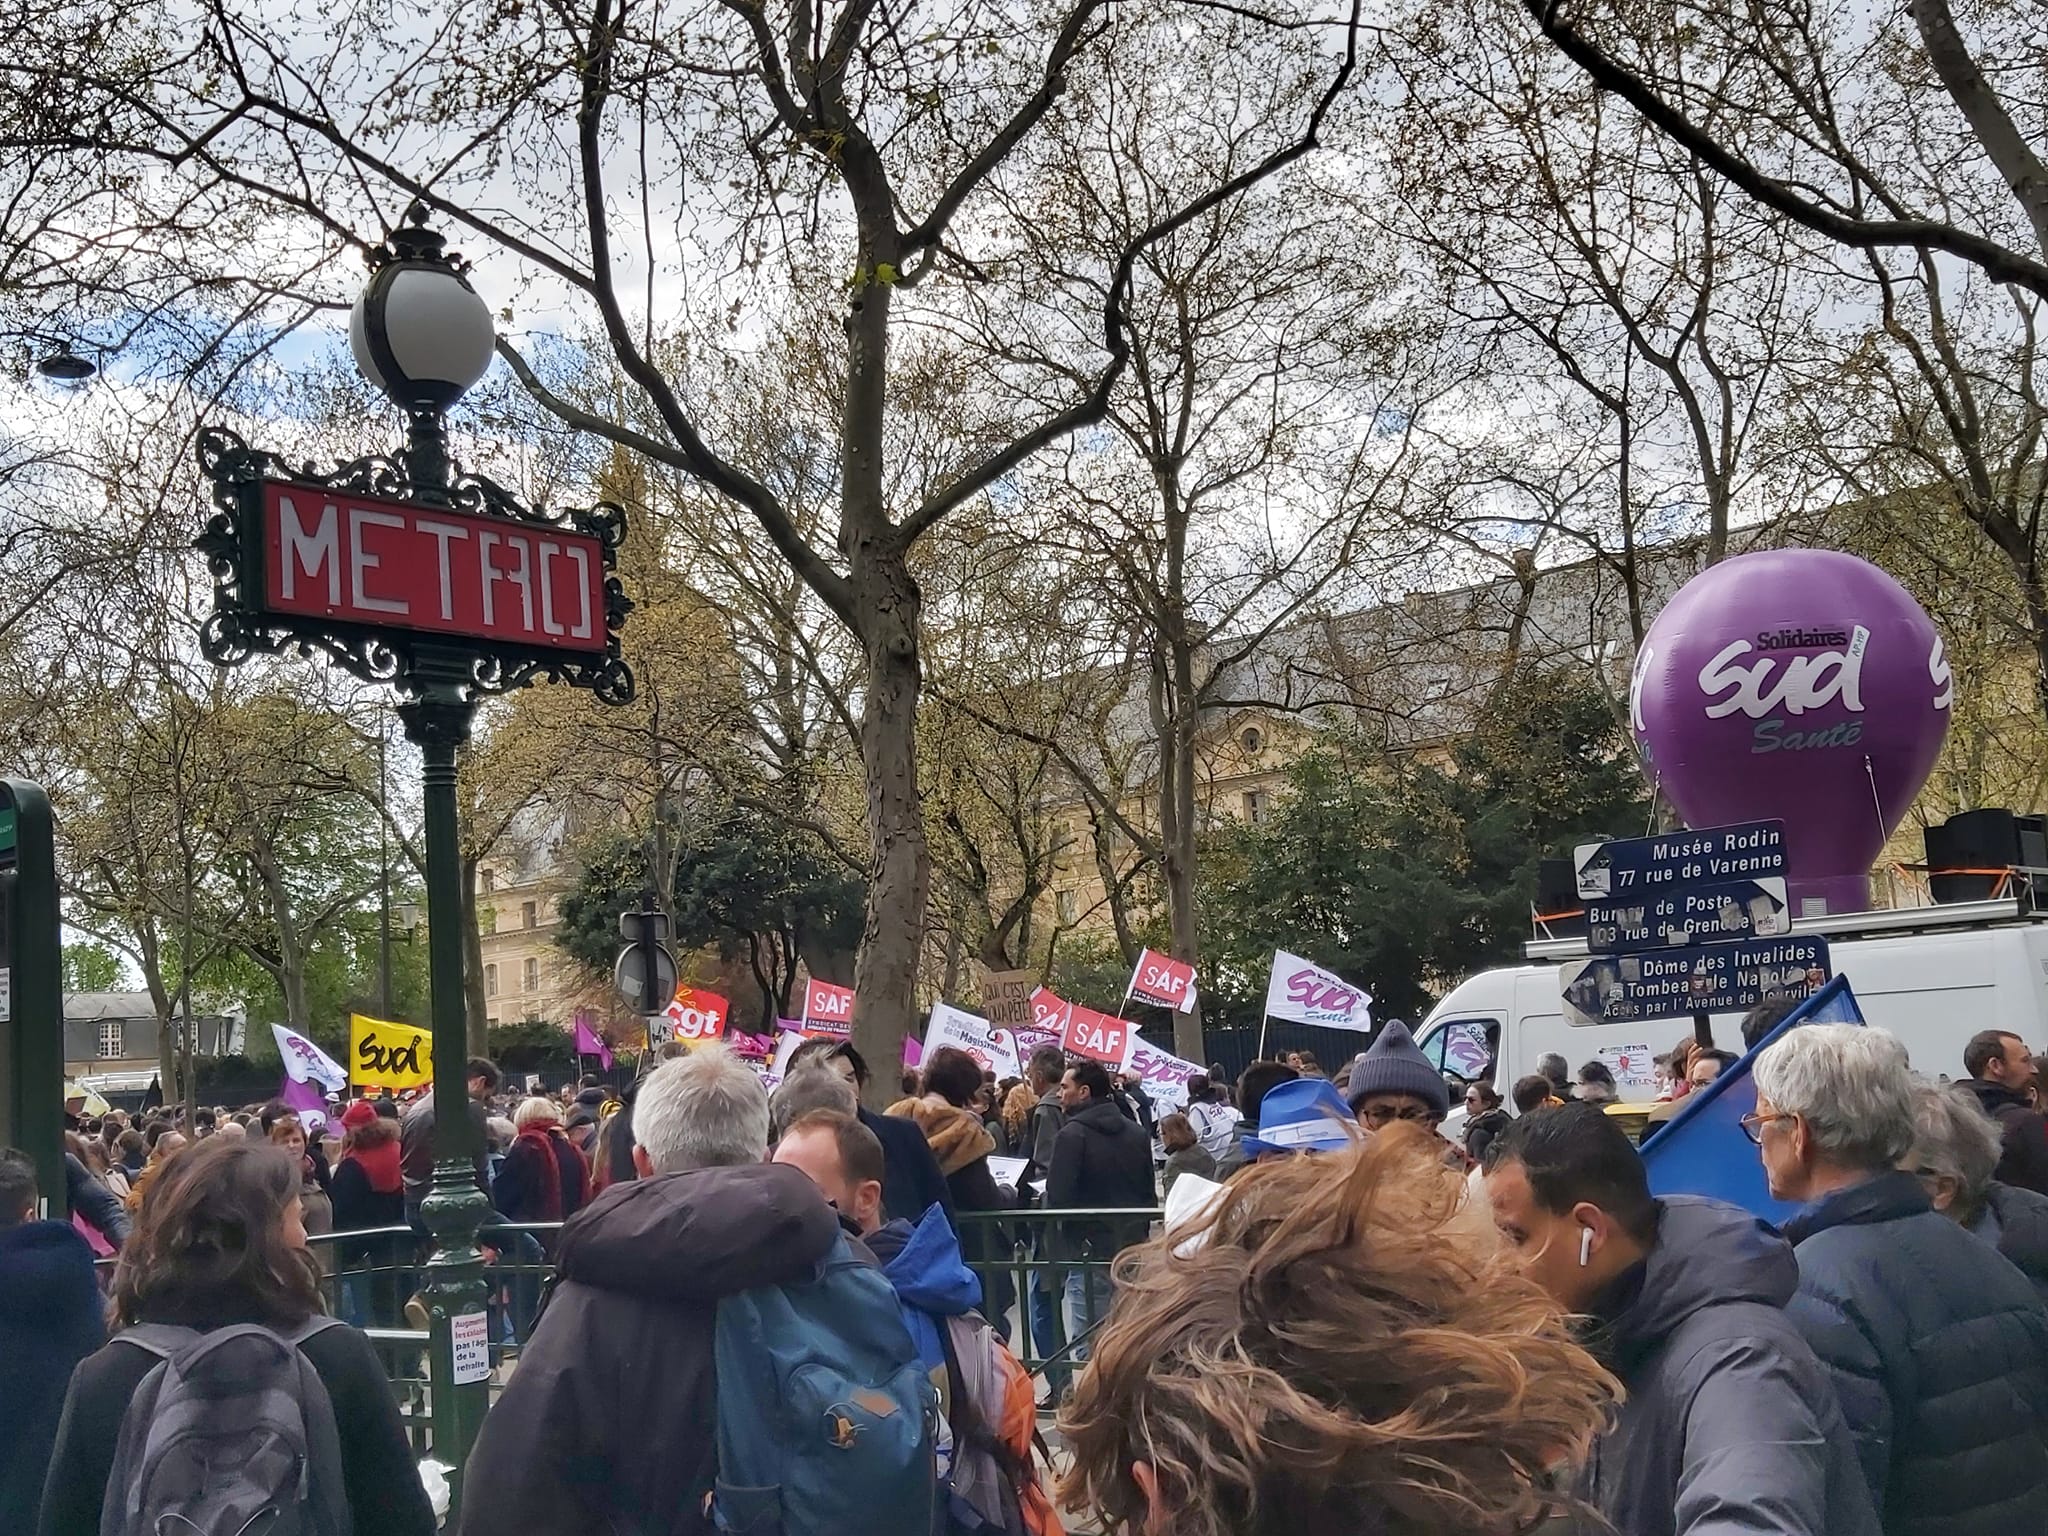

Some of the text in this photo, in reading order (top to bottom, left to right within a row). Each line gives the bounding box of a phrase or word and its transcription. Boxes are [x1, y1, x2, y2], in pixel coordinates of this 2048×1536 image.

[278, 495, 593, 640] METRO
[1757, 628, 1848, 650] Solidaires
[1750, 719, 1863, 754] Santé
[1653, 829, 1780, 860] Musée Rodin
[1617, 854, 1782, 887] 77 rue de Varenne
[1656, 899, 1675, 916] de
[1686, 895, 1732, 913] Poste
[1625, 926, 1649, 941] rue
[1657, 920, 1675, 938] de
[1683, 916, 1749, 935] Grene
[1643, 944, 1816, 977] Dôme des Invalides
[1143, 966, 1185, 994] SAF
[1627, 978, 1690, 998] Tombea
[1737, 965, 1807, 991] Napol
[814, 991, 851, 1015] SAF
[1646, 1001, 1667, 1016] par
[1739, 991, 1755, 1005] de
[1074, 1022, 1121, 1054] SAF
[456, 1342, 470, 1352] pas
[456, 1353, 467, 1361] de
[456, 1361, 485, 1372] retraite
